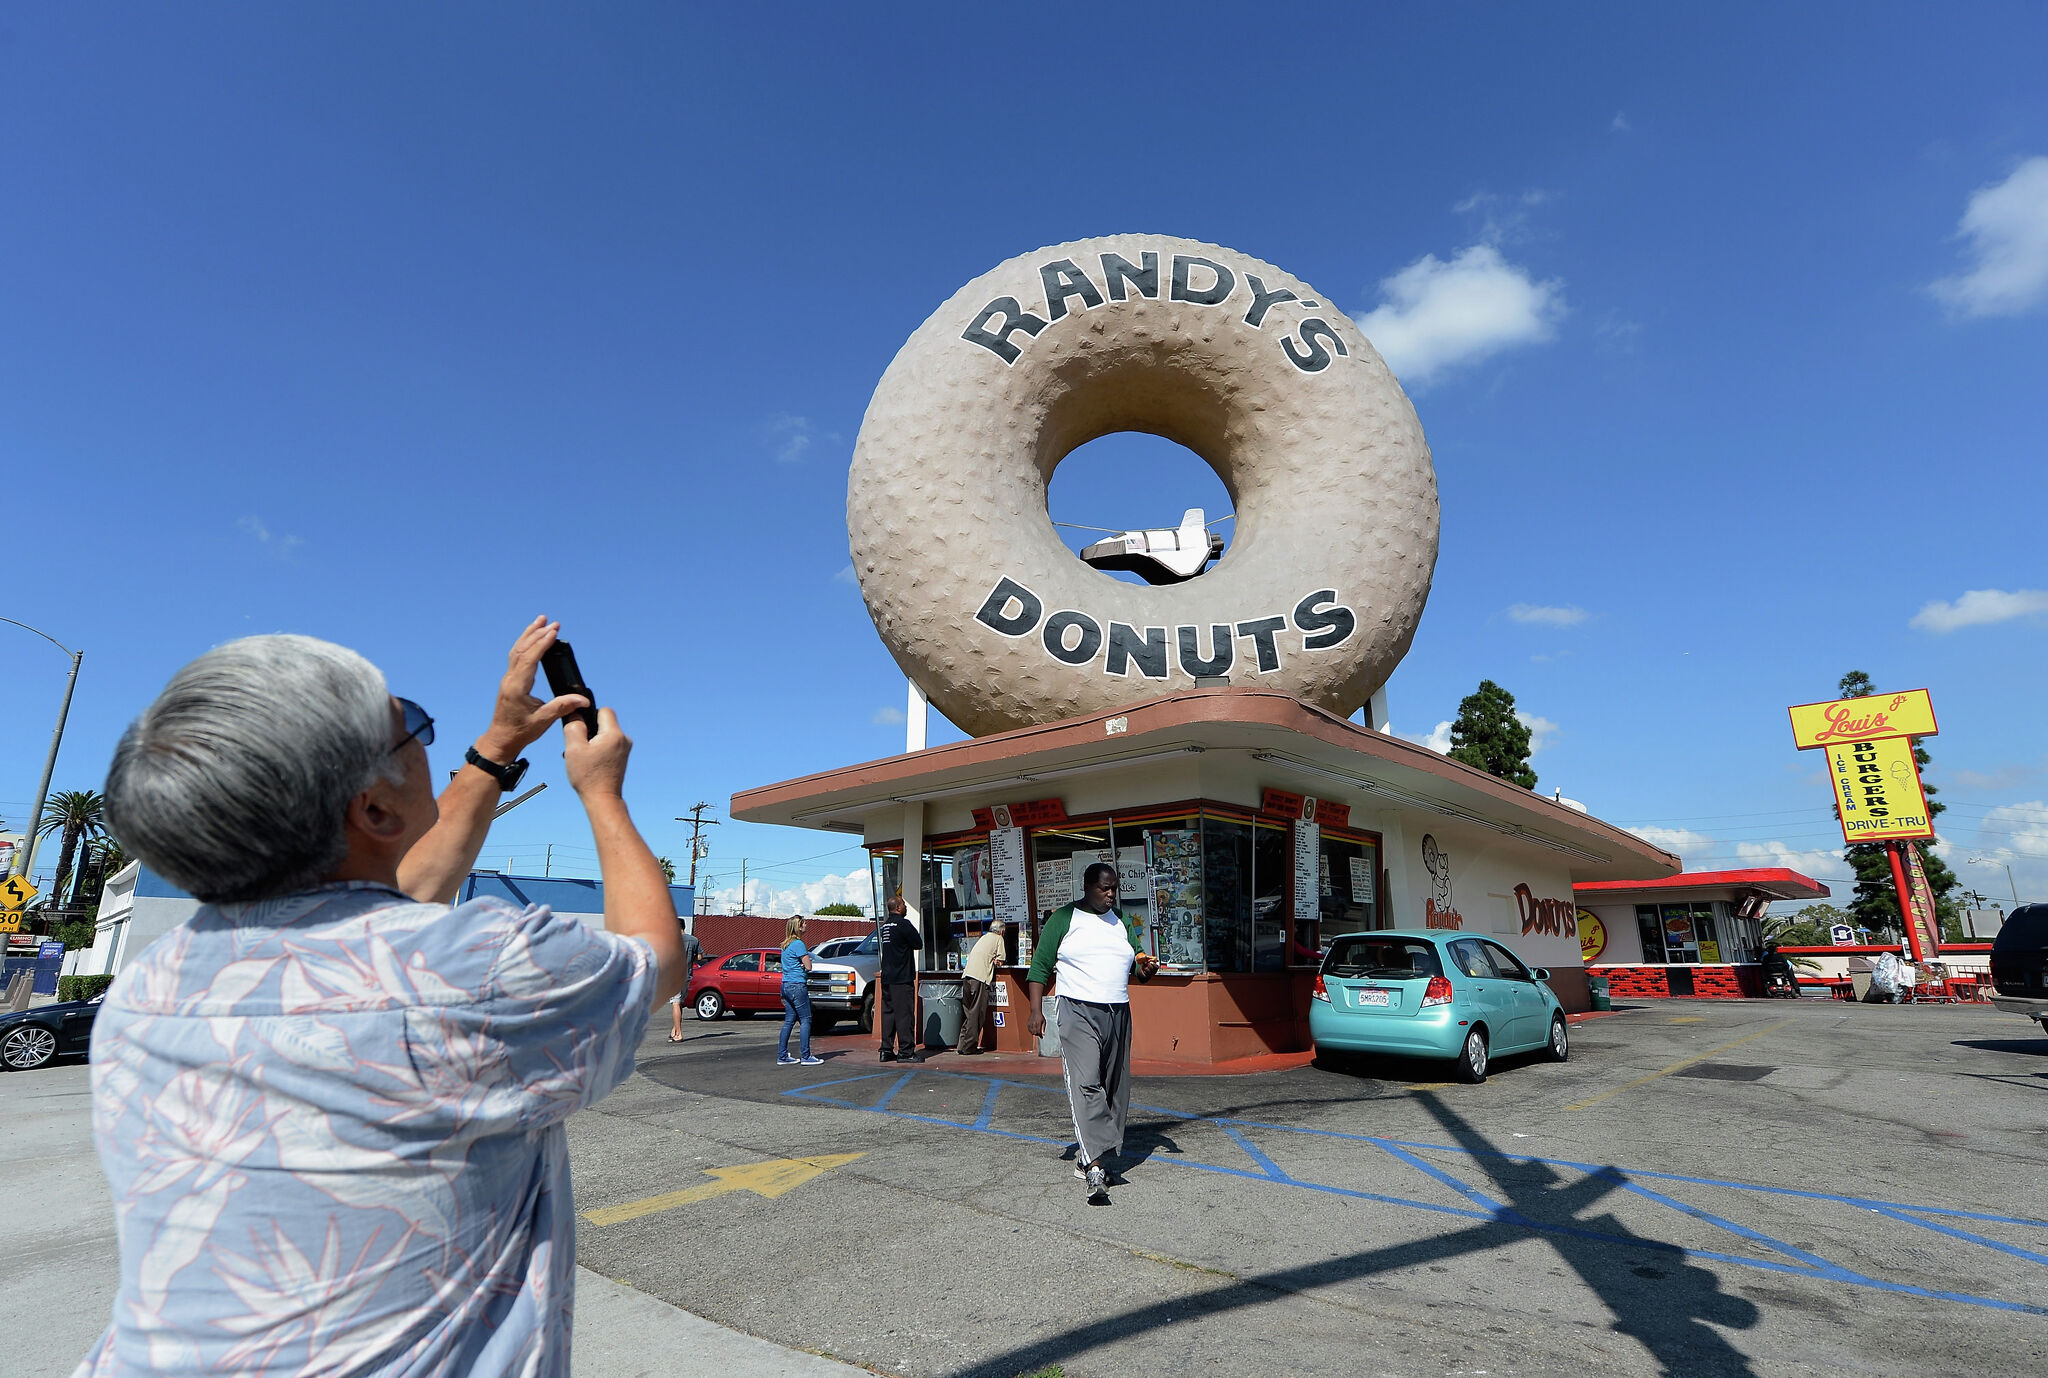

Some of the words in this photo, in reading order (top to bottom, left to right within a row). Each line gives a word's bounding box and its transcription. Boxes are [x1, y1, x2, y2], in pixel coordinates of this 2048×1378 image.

[960, 250, 1349, 374] RANDY'S
[974, 575, 1357, 680] DONUTS
[1815, 703, 1893, 741] Louis
[1889, 695, 1907, 712] Jr
[1836, 753, 1847, 773] ICE
[1852, 742, 1889, 817] BURGERS
[1840, 778, 1857, 811] CREAM
[1846, 816, 1927, 831] DRIVE-TRU
[1128, 869, 1146, 879] Chip
[0, 913, 20, 925] 30
